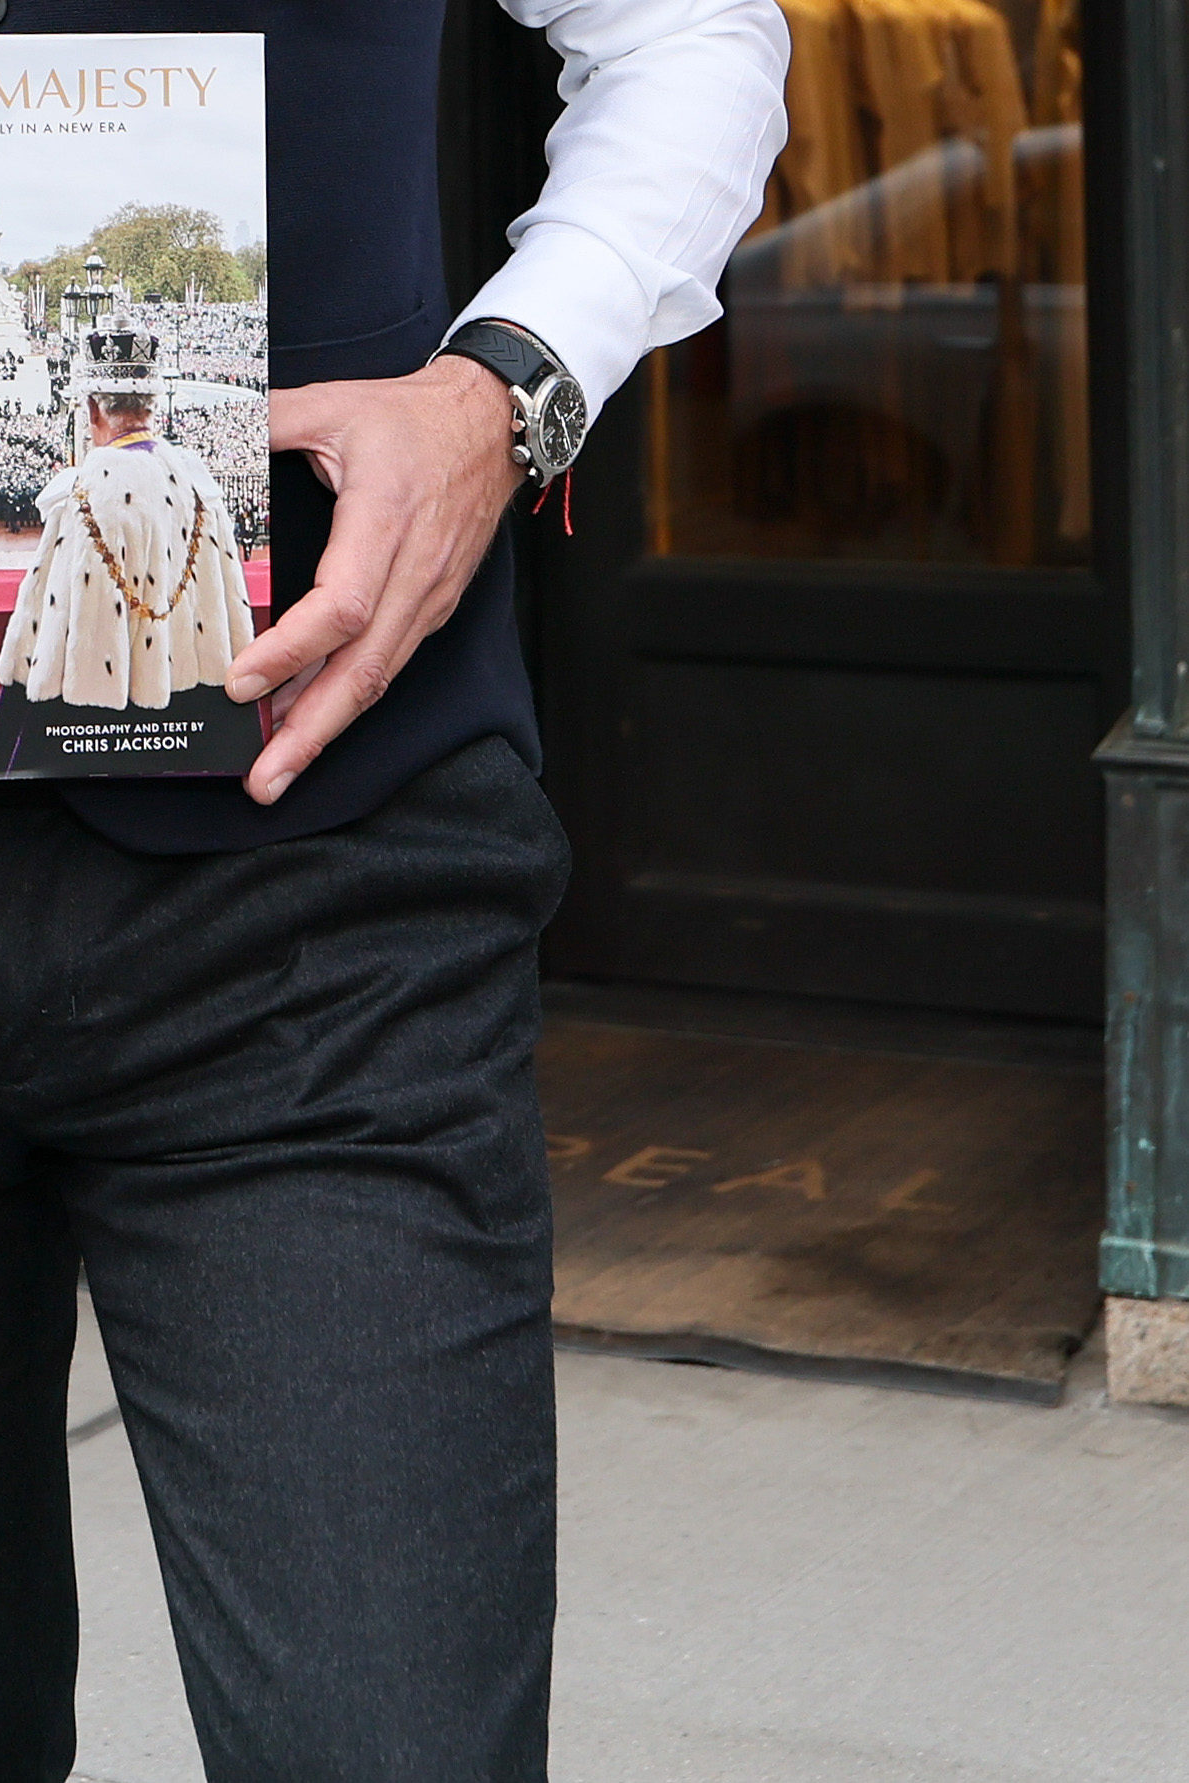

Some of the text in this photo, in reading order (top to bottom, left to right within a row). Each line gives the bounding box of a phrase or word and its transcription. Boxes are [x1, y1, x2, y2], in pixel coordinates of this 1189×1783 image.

[21, 122, 37, 135] IN
[43, 122, 53, 134] A
[59, 122, 94, 134] NEW
[99, 121, 128, 133] ERA
[45, 721, 205, 737] PHOTOGRAPHY AND TEXT BY
[62, 735, 189, 754] CHRIS JACKSON
